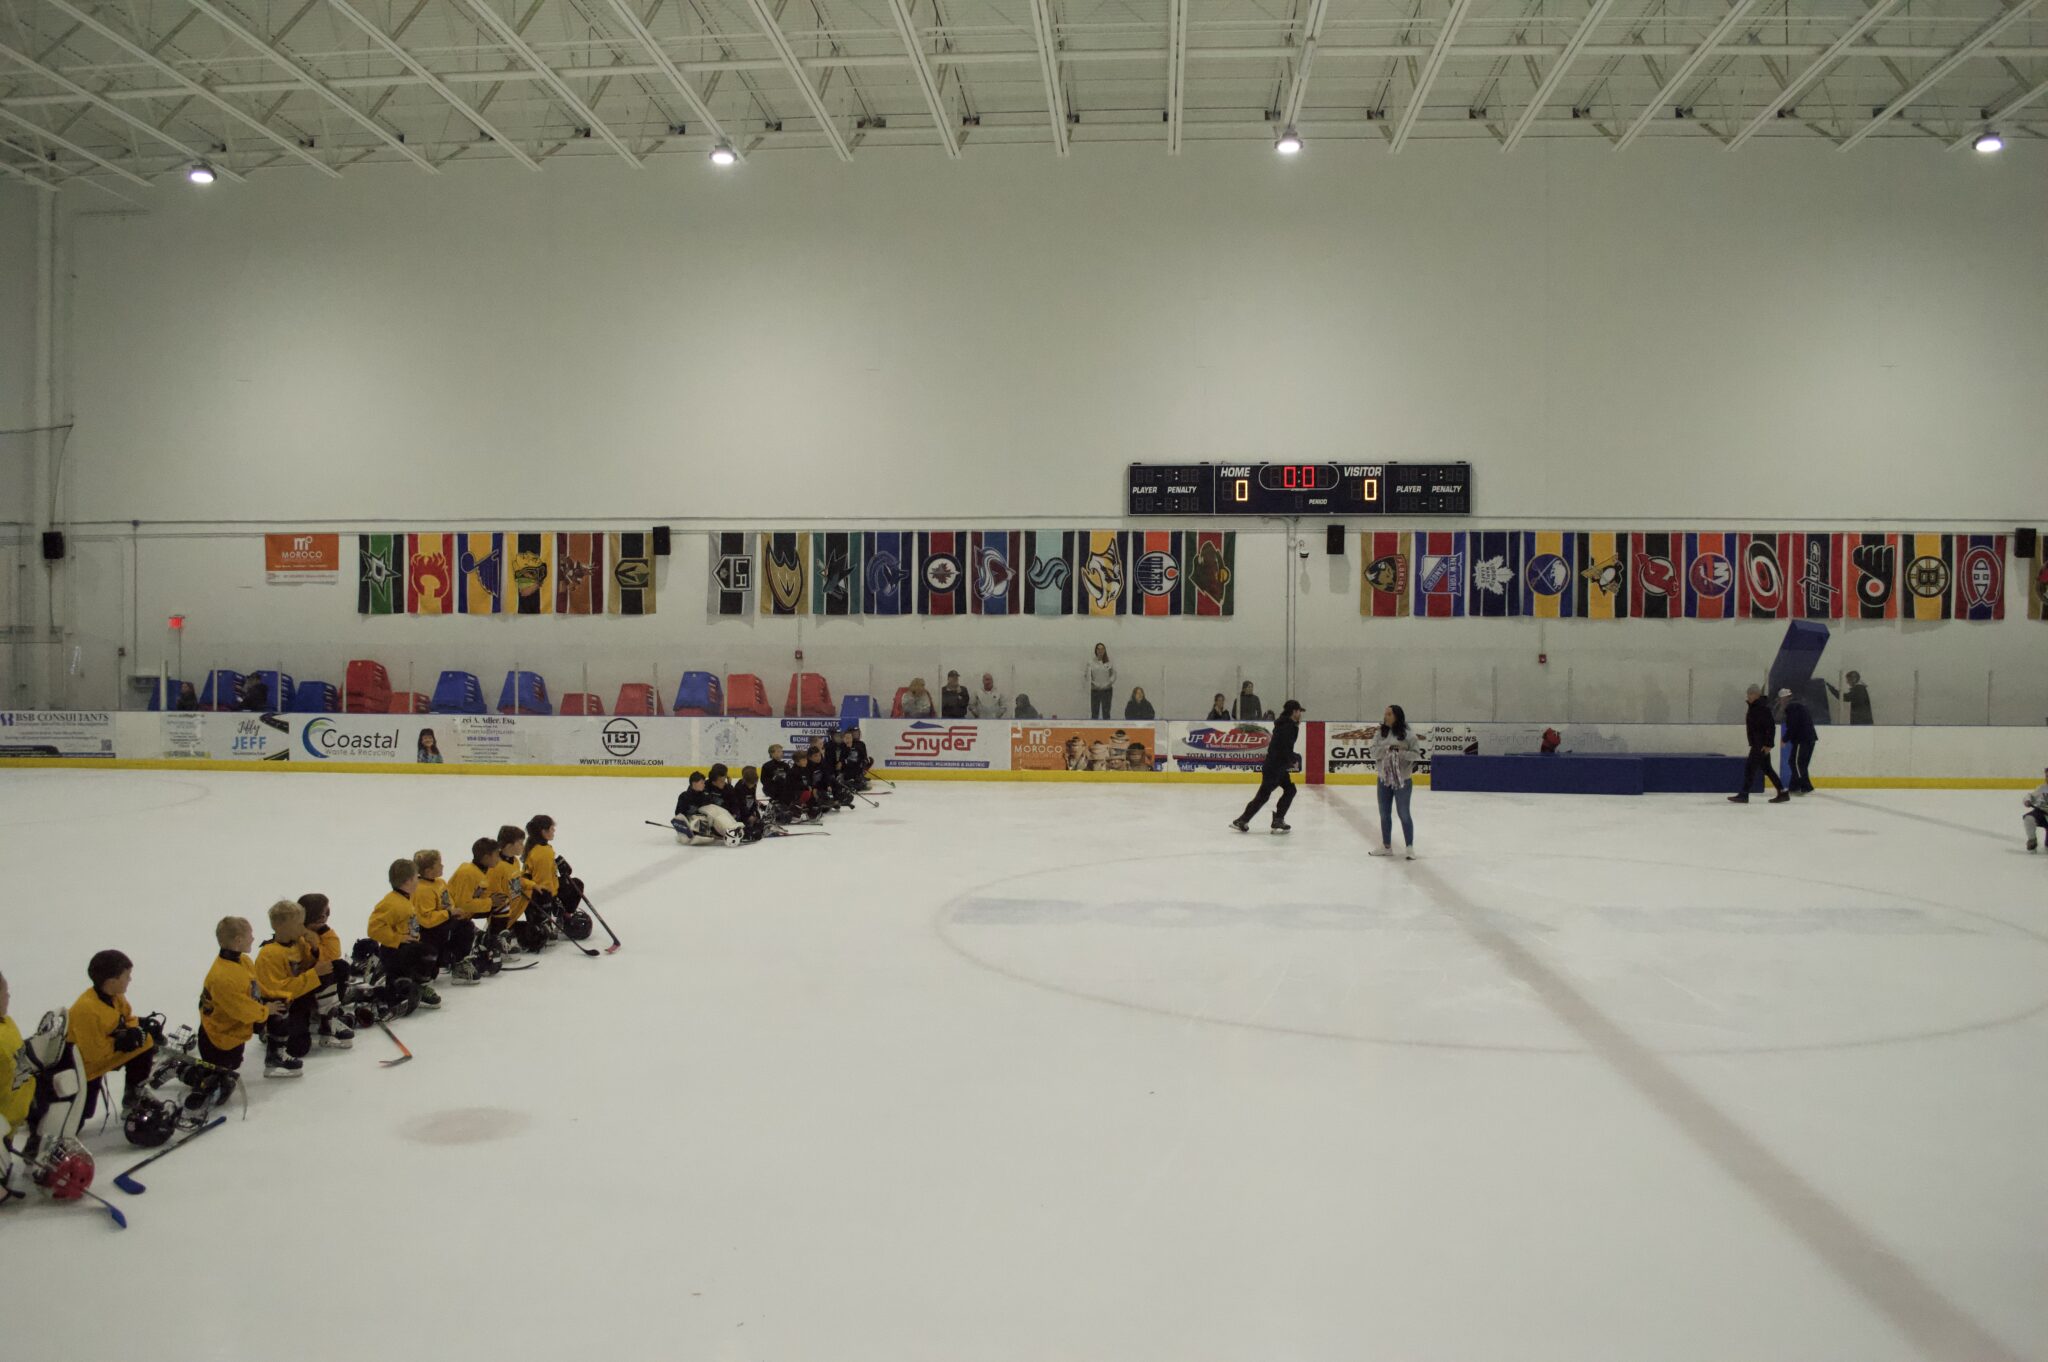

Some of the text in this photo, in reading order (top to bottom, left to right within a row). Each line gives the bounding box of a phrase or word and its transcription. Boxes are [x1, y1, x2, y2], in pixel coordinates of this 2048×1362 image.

[1220, 466, 1251, 478] HOME
[1343, 466, 1382, 478] VISITOR
[1132, 486, 1197, 494] PLAYER PENALTY
[1235, 479, 1249, 502] 0
[1364, 479, 1377, 502] 0
[1395, 485, 1462, 494] PLAYER PENALTY
[281, 551, 323, 560] MOROCO
[15, 713, 36, 722] BSB
[809, 720, 840, 728] IMPLANTS
[321, 728, 399, 749] Coastal
[605, 731, 637, 744] TBT
[895, 726, 978, 757] Snyder
[1205, 733, 1268, 744] Miller
[231, 736, 267, 750] JEFF
[1434, 744, 1464, 752] DOORS
[359, 749, 396, 758] Recycling
[1014, 745, 1063, 754] MOROCO
[1186, 752, 1209, 760] TOTAL
[1229, 752, 1265, 761] SOLUTION
